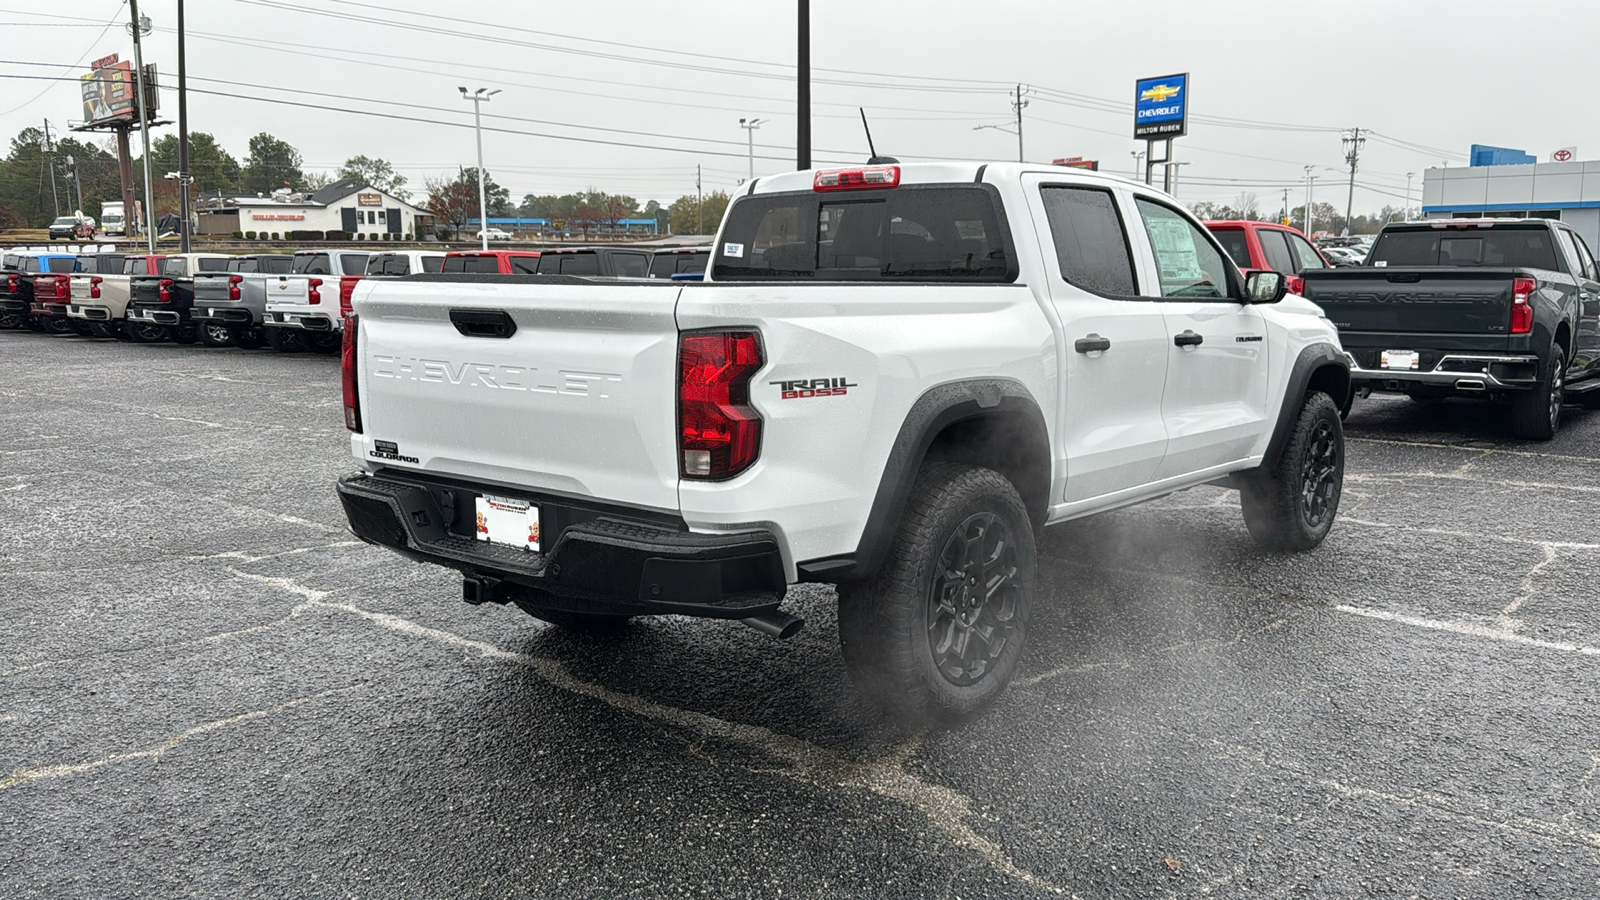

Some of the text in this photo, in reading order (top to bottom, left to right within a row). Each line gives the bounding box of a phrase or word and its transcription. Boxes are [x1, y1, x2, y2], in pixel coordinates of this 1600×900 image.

[1138, 106, 1180, 118] CHEVROLET
[1137, 124, 1180, 135] MILTON RUBEN
[1316, 292, 1496, 305] CHEVROLET
[374, 355, 622, 398] CHEVROLET
[769, 377, 858, 391] TRAIL
[781, 388, 847, 400] BOSS
[369, 450, 420, 464] COLORADO
